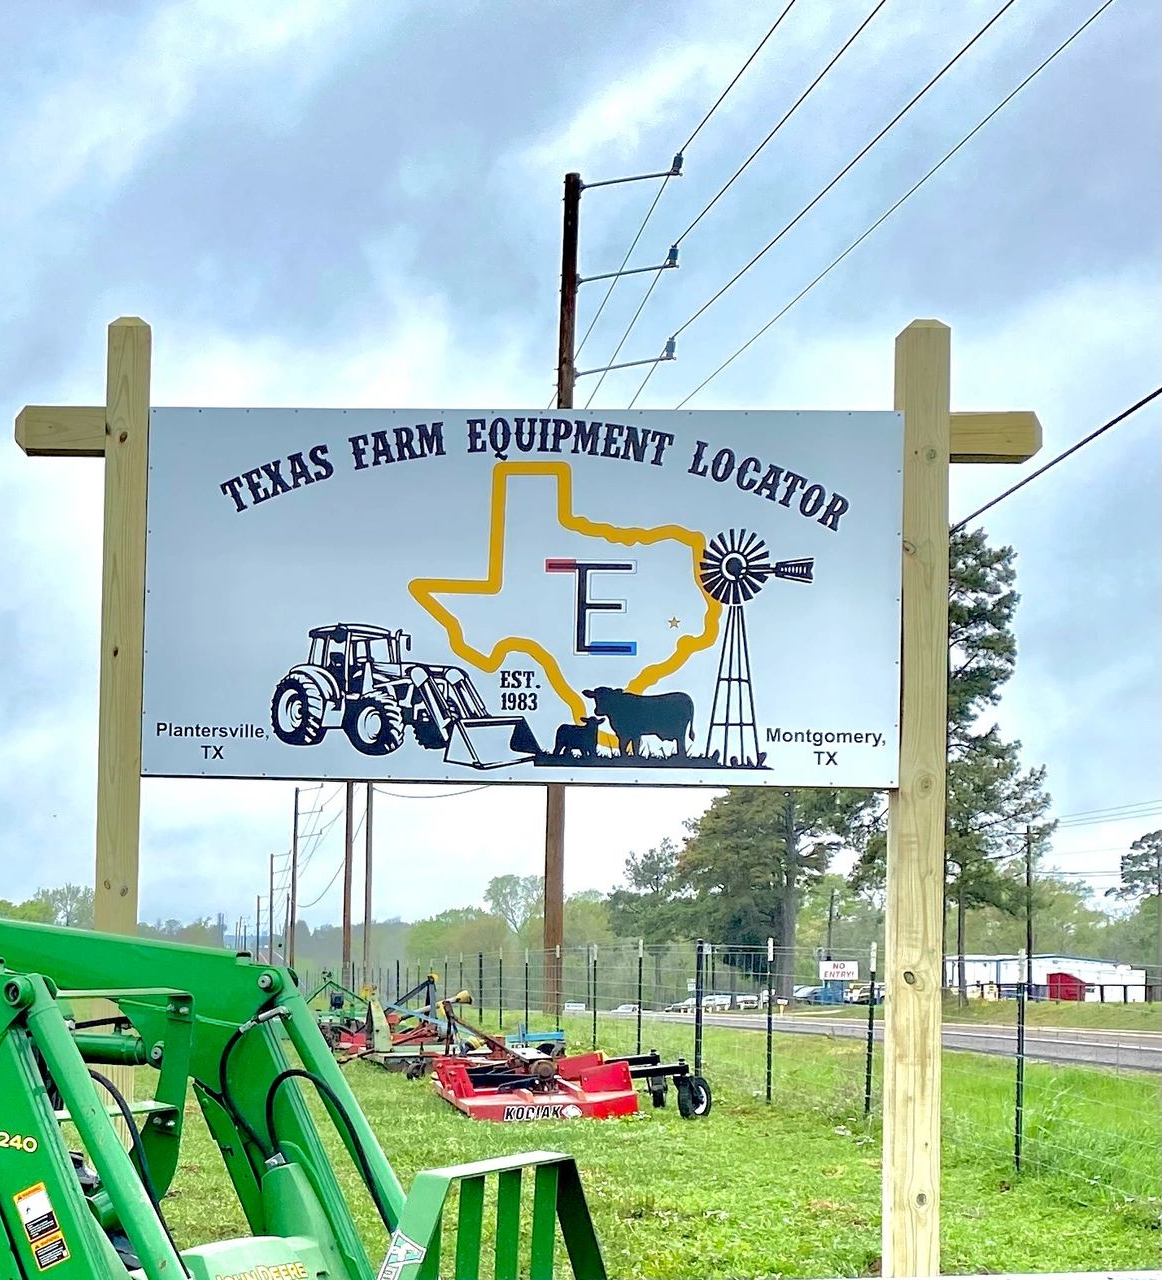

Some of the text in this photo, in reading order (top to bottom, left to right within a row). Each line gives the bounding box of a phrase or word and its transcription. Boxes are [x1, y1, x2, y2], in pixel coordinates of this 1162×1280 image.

[220, 417, 850, 532] TEXAS FARM EQUIPMENT LOCATOR
[499, 671, 541, 689] EST.
[500, 693, 538, 711] 1983
[155, 722, 270, 741] Plantersville,
[766, 727, 886, 747] Montgomery,
[200, 745, 225, 760] TX
[813, 751, 838, 766] TX
[824, 970, 855, 978] ENTRY!
[832, 962, 846, 970] NO
